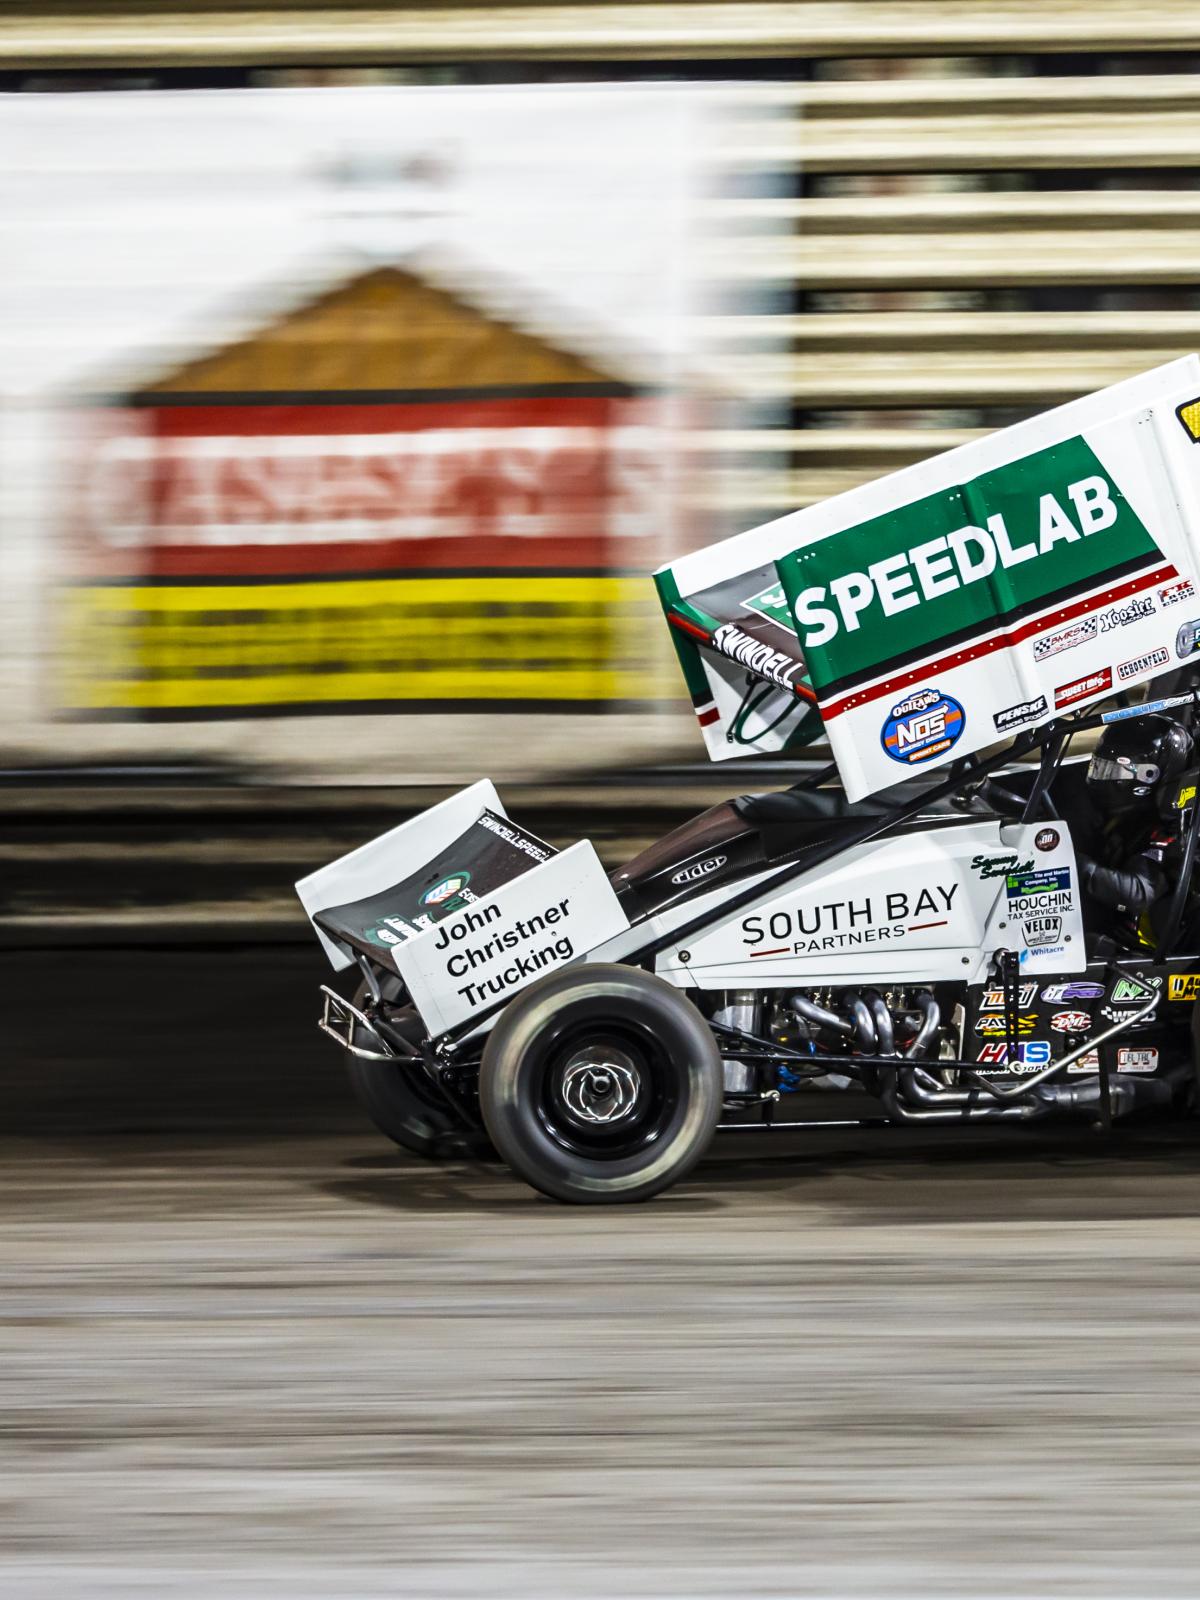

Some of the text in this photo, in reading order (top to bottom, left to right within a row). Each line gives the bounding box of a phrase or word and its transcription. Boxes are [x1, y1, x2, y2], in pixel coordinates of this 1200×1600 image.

[795, 475, 1118, 647] SPEEDLAB
[1169, 586, 1194, 600] ROD
[1100, 597, 1153, 632] Hoosier
[712, 623, 803, 690] SWINDELL
[1118, 650, 1167, 678] SCHOENFELD
[896, 702, 949, 749] NOS
[997, 698, 1045, 724] PENSKE
[742, 883, 958, 944] SOUTH BAY
[1008, 892, 1072, 912] HOUCHIN
[1025, 907, 1057, 918] SERVICE
[434, 904, 502, 950] John
[446, 898, 570, 978] Christner
[793, 925, 906, 954] PARTNERS
[1024, 918, 1059, 934] VELOX
[1031, 946, 1065, 956] Whitacre
[457, 937, 574, 1007] Trucking
